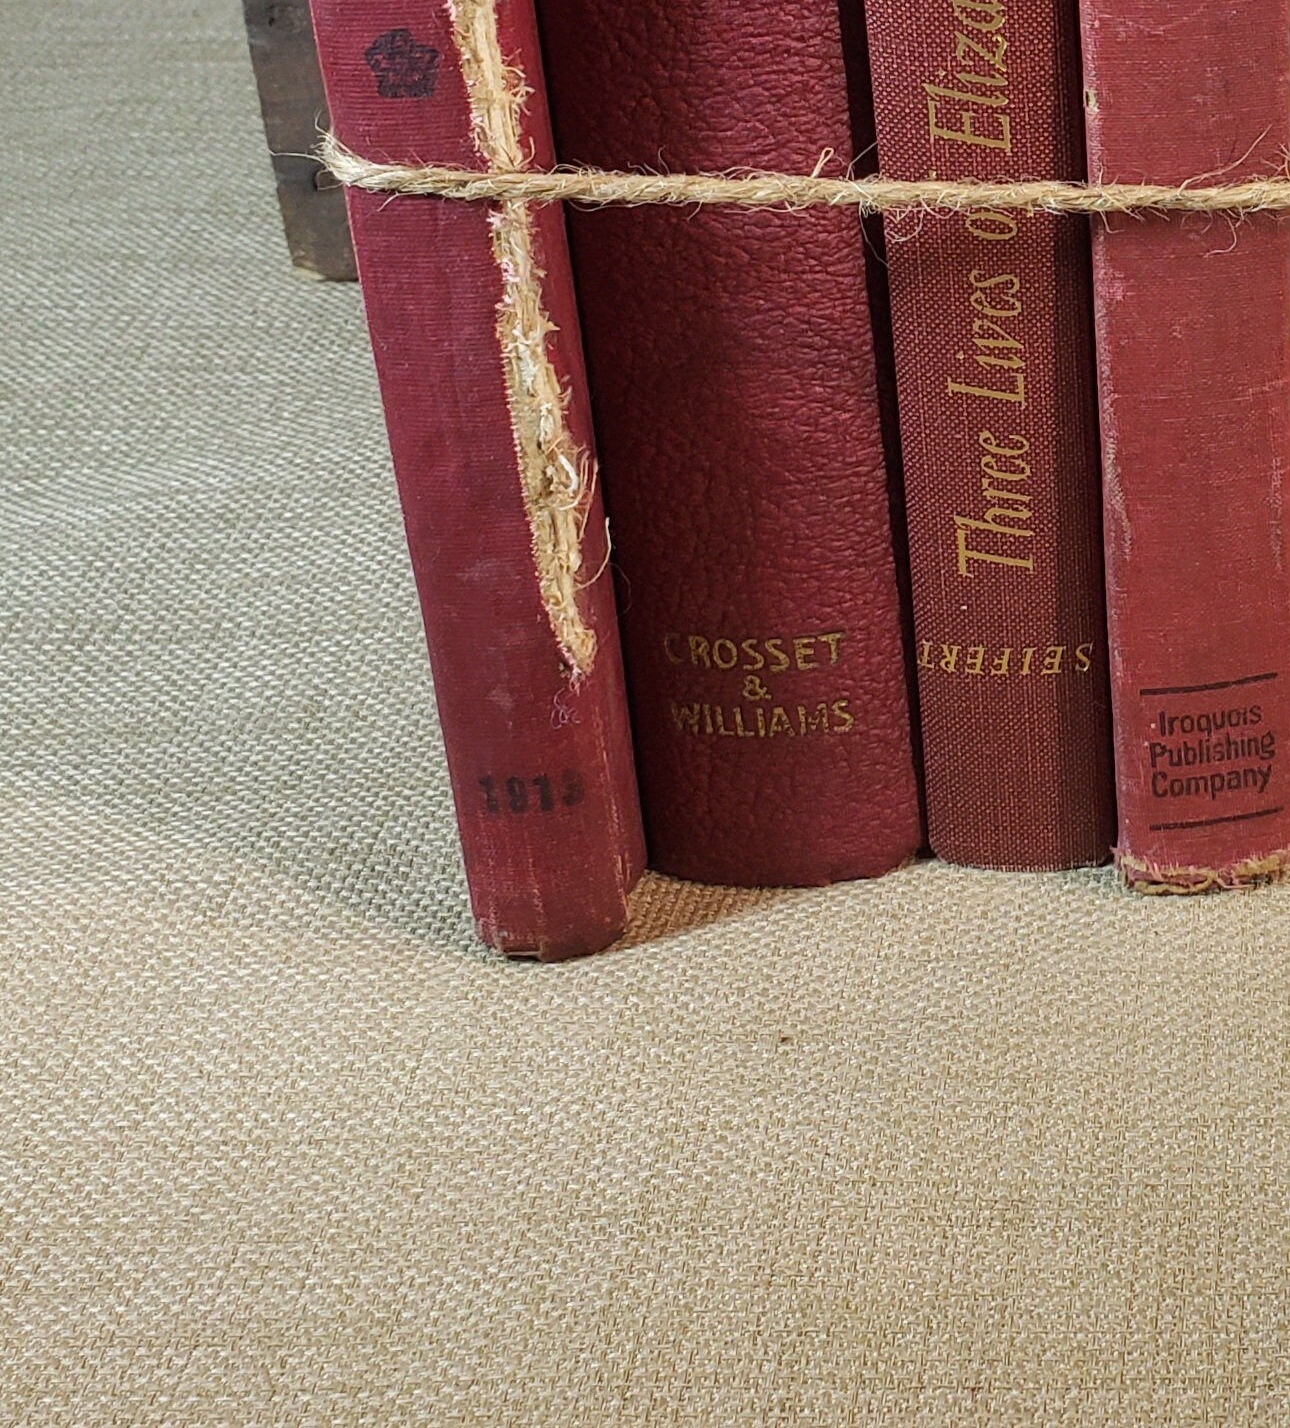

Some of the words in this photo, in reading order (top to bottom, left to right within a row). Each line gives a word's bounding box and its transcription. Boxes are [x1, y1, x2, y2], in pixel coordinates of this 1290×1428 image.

[948, 269, 1026, 408] Lives
[956, 429, 1035, 578] Three
[663, 630, 846, 673] CROSSET
[916, 638, 1094, 676] SEIFERT
[741, 674, 773, 701] &
[670, 699, 856, 739] WILLIAMS
[1158, 704, 1263, 737] Iroquois
[1149, 730, 1277, 769] Publishing
[1151, 763, 1273, 801] Company
